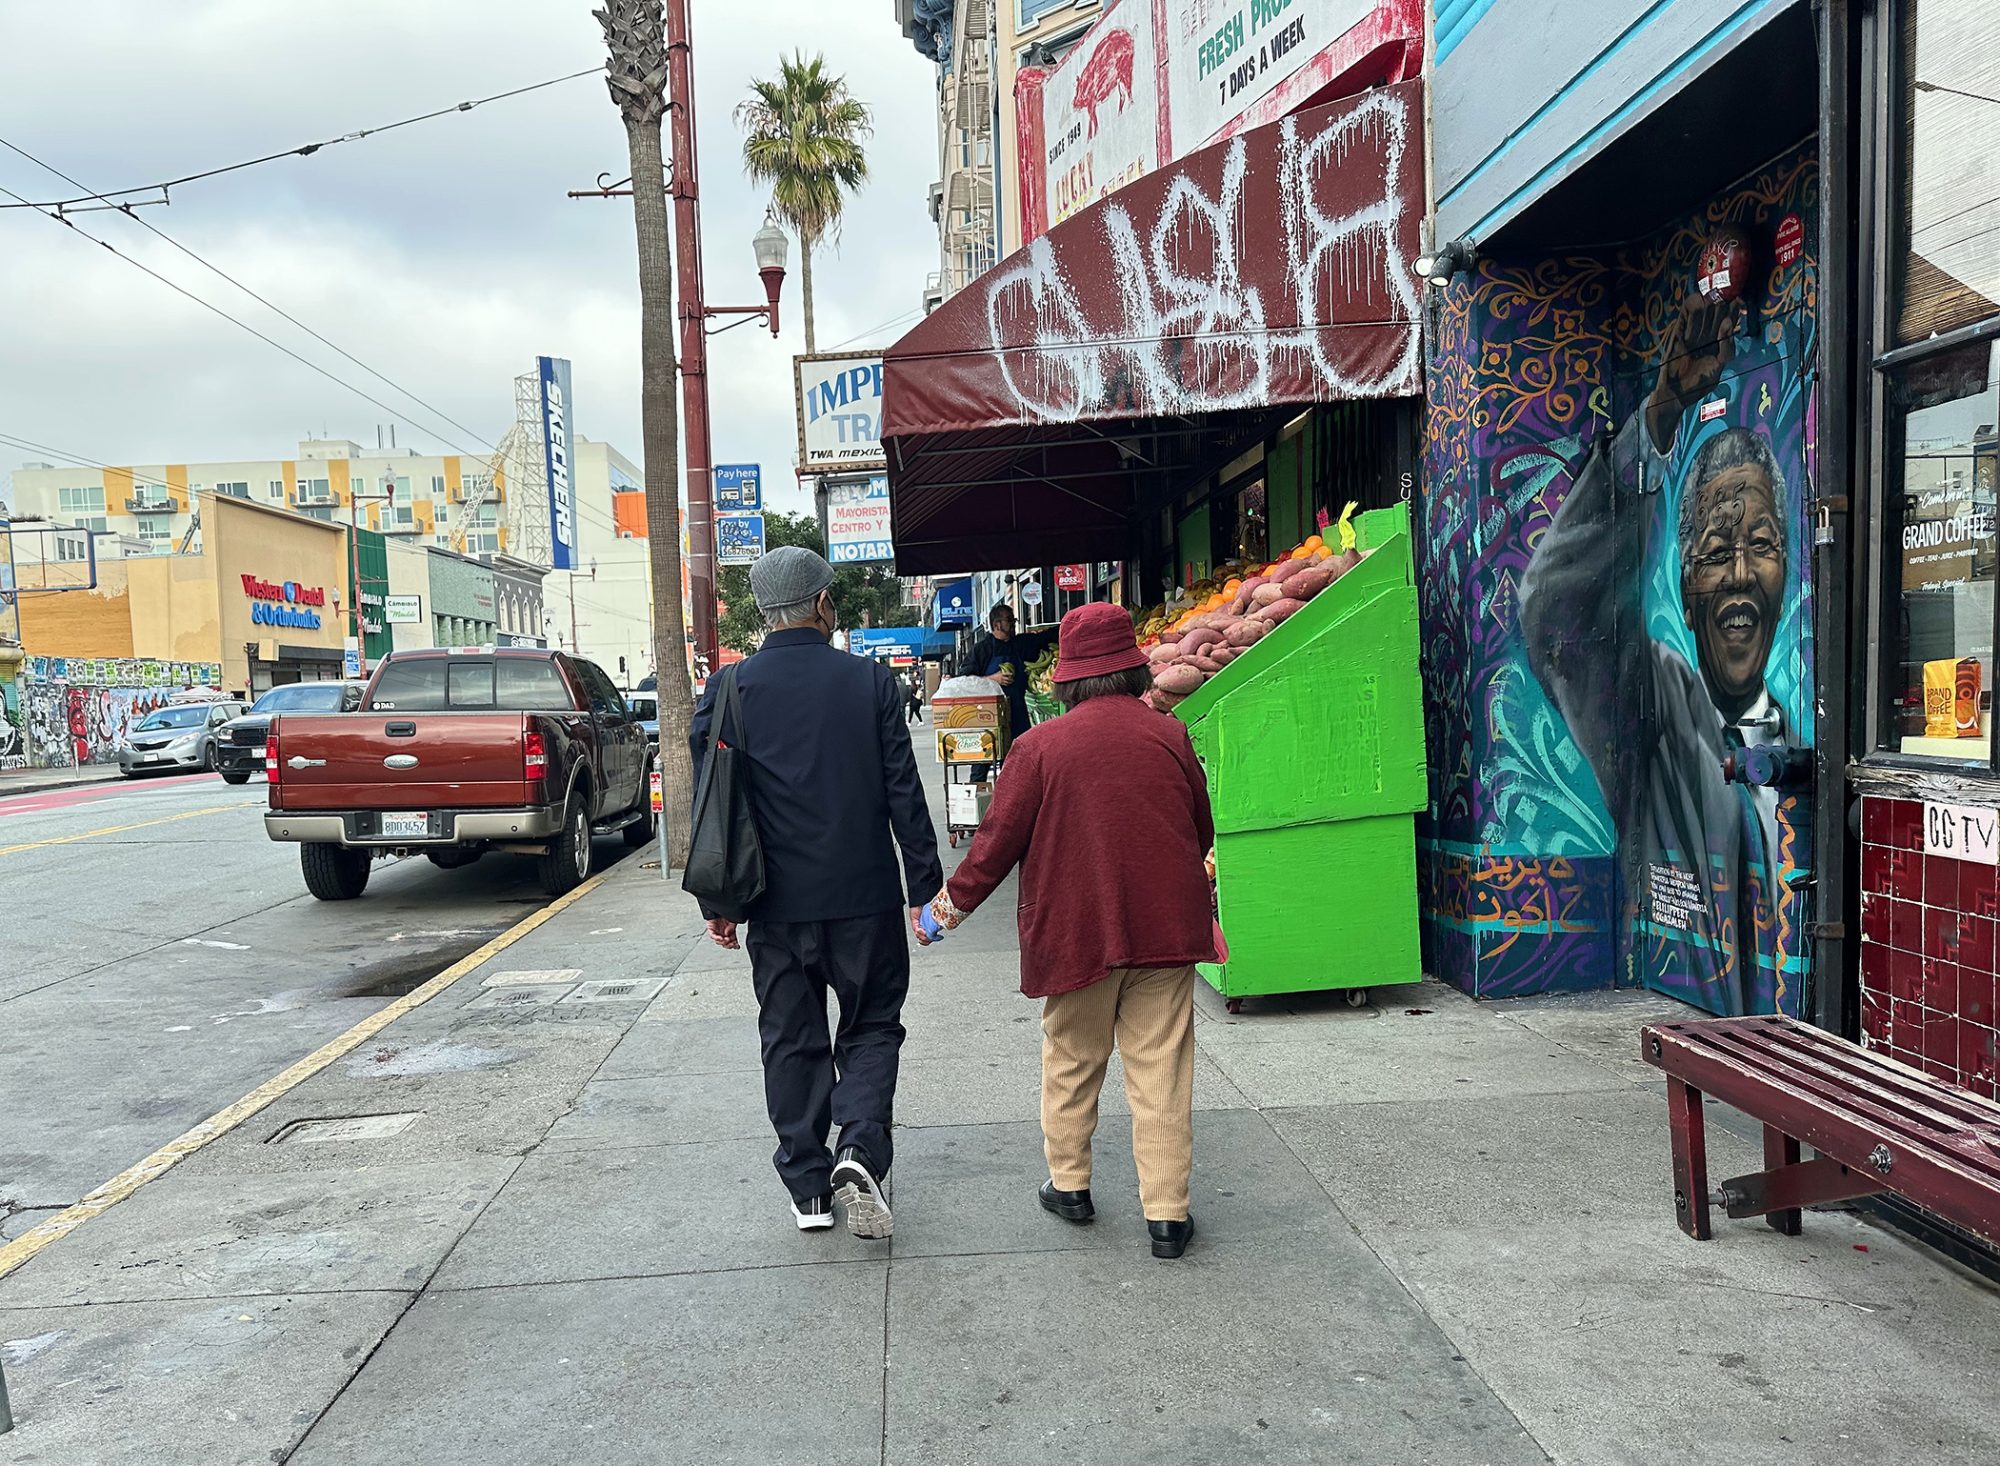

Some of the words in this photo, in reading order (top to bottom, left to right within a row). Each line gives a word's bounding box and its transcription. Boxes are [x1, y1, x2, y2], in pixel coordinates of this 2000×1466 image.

[1199, 10, 1244, 81] FRESH
[1220, 80, 1226, 106] 7
[1229, 55, 1256, 98] DAYS
[1260, 45, 1269, 75] A
[1270, 13, 1306, 63] WEEK
[1049, 138, 1065, 165] SINCE
[1067, 121, 1081, 147] 1949
[546, 380, 573, 548] SKECHERS
[810, 449, 833, 460] TWA
[717, 468, 735, 480] Pay
[736, 467, 758, 478] here
[738, 519, 749, 529] by
[836, 506, 889, 519] MAYORISTA
[831, 522, 872, 534] CENTRO
[876, 519, 883, 531] Y
[1903, 520, 1943, 550] GRAND
[1945, 512, 1987, 543] COFFEE
[1909, 556, 1926, 564] COFFEE
[241, 575, 284, 602] Western
[293, 583, 325, 607] Dental
